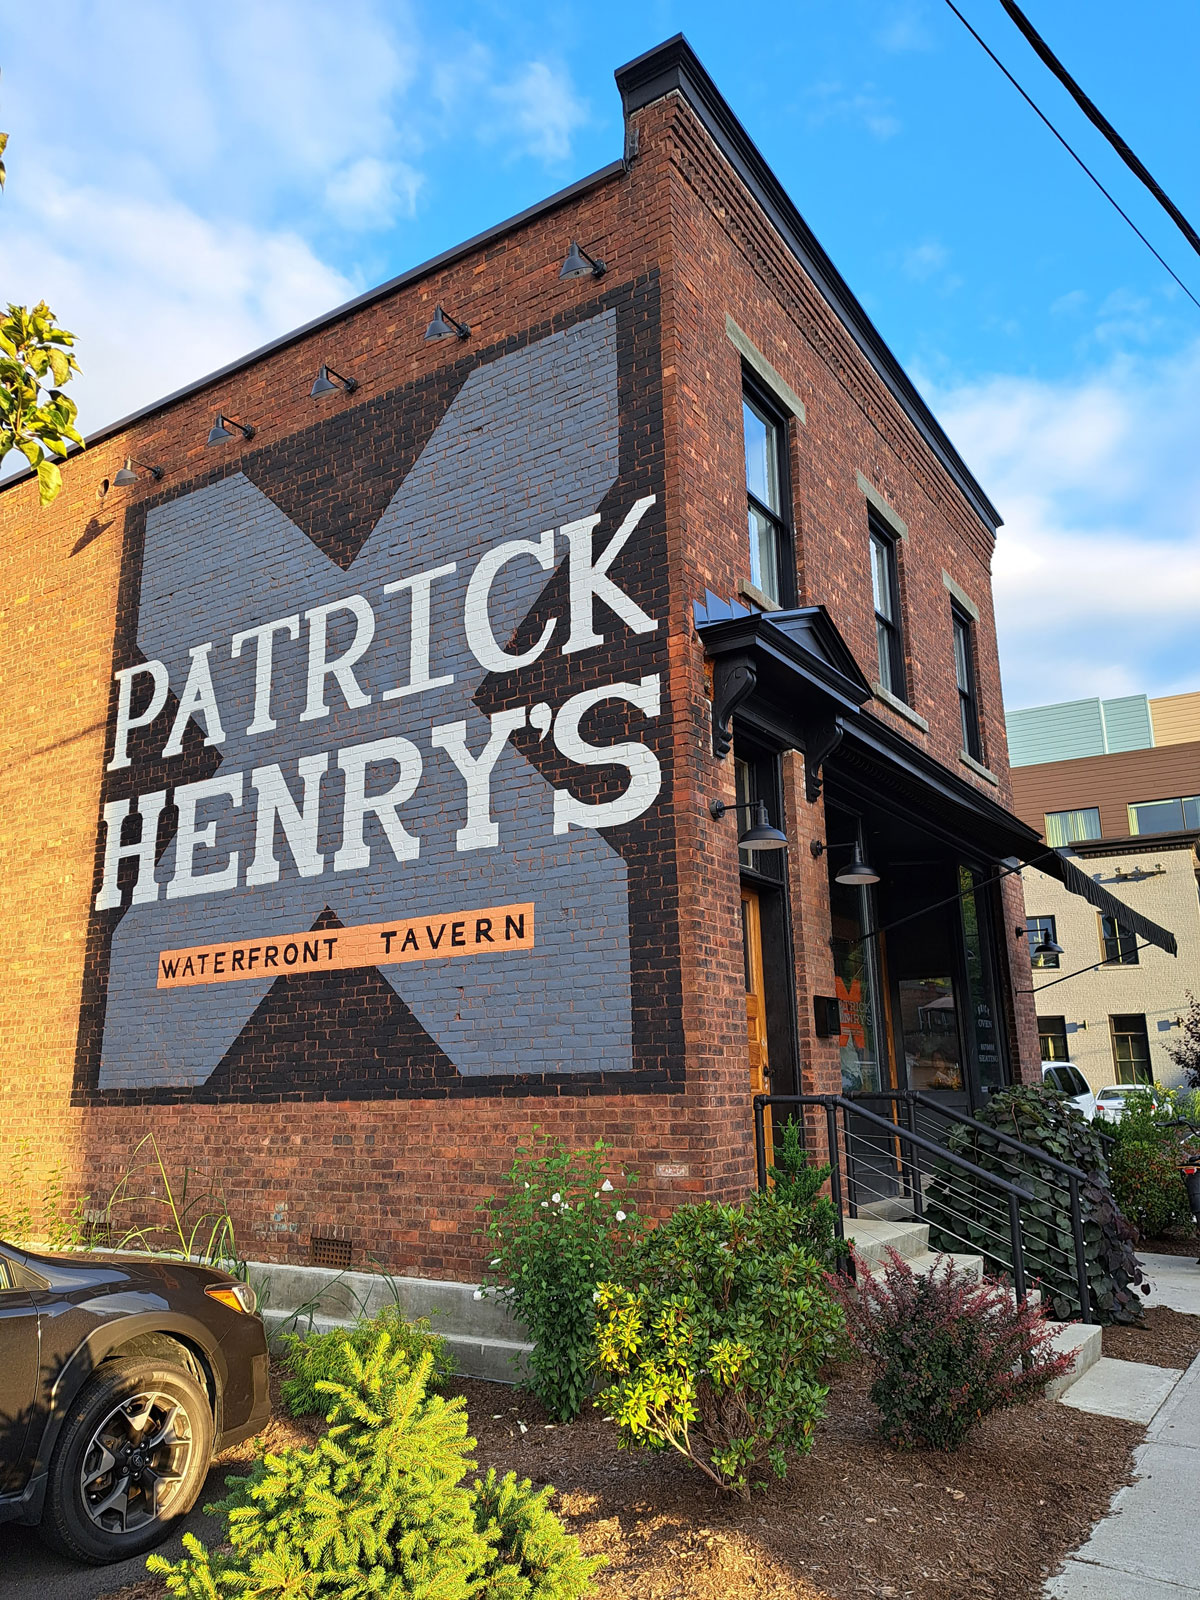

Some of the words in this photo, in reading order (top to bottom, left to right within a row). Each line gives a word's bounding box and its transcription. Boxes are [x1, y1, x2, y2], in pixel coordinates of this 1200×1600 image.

[106, 494, 659, 772] PATRICK
[94, 673, 662, 911] HENRY'S
[161, 937, 338, 979] WATERFRONT
[380, 913, 525, 954] TAVERN
